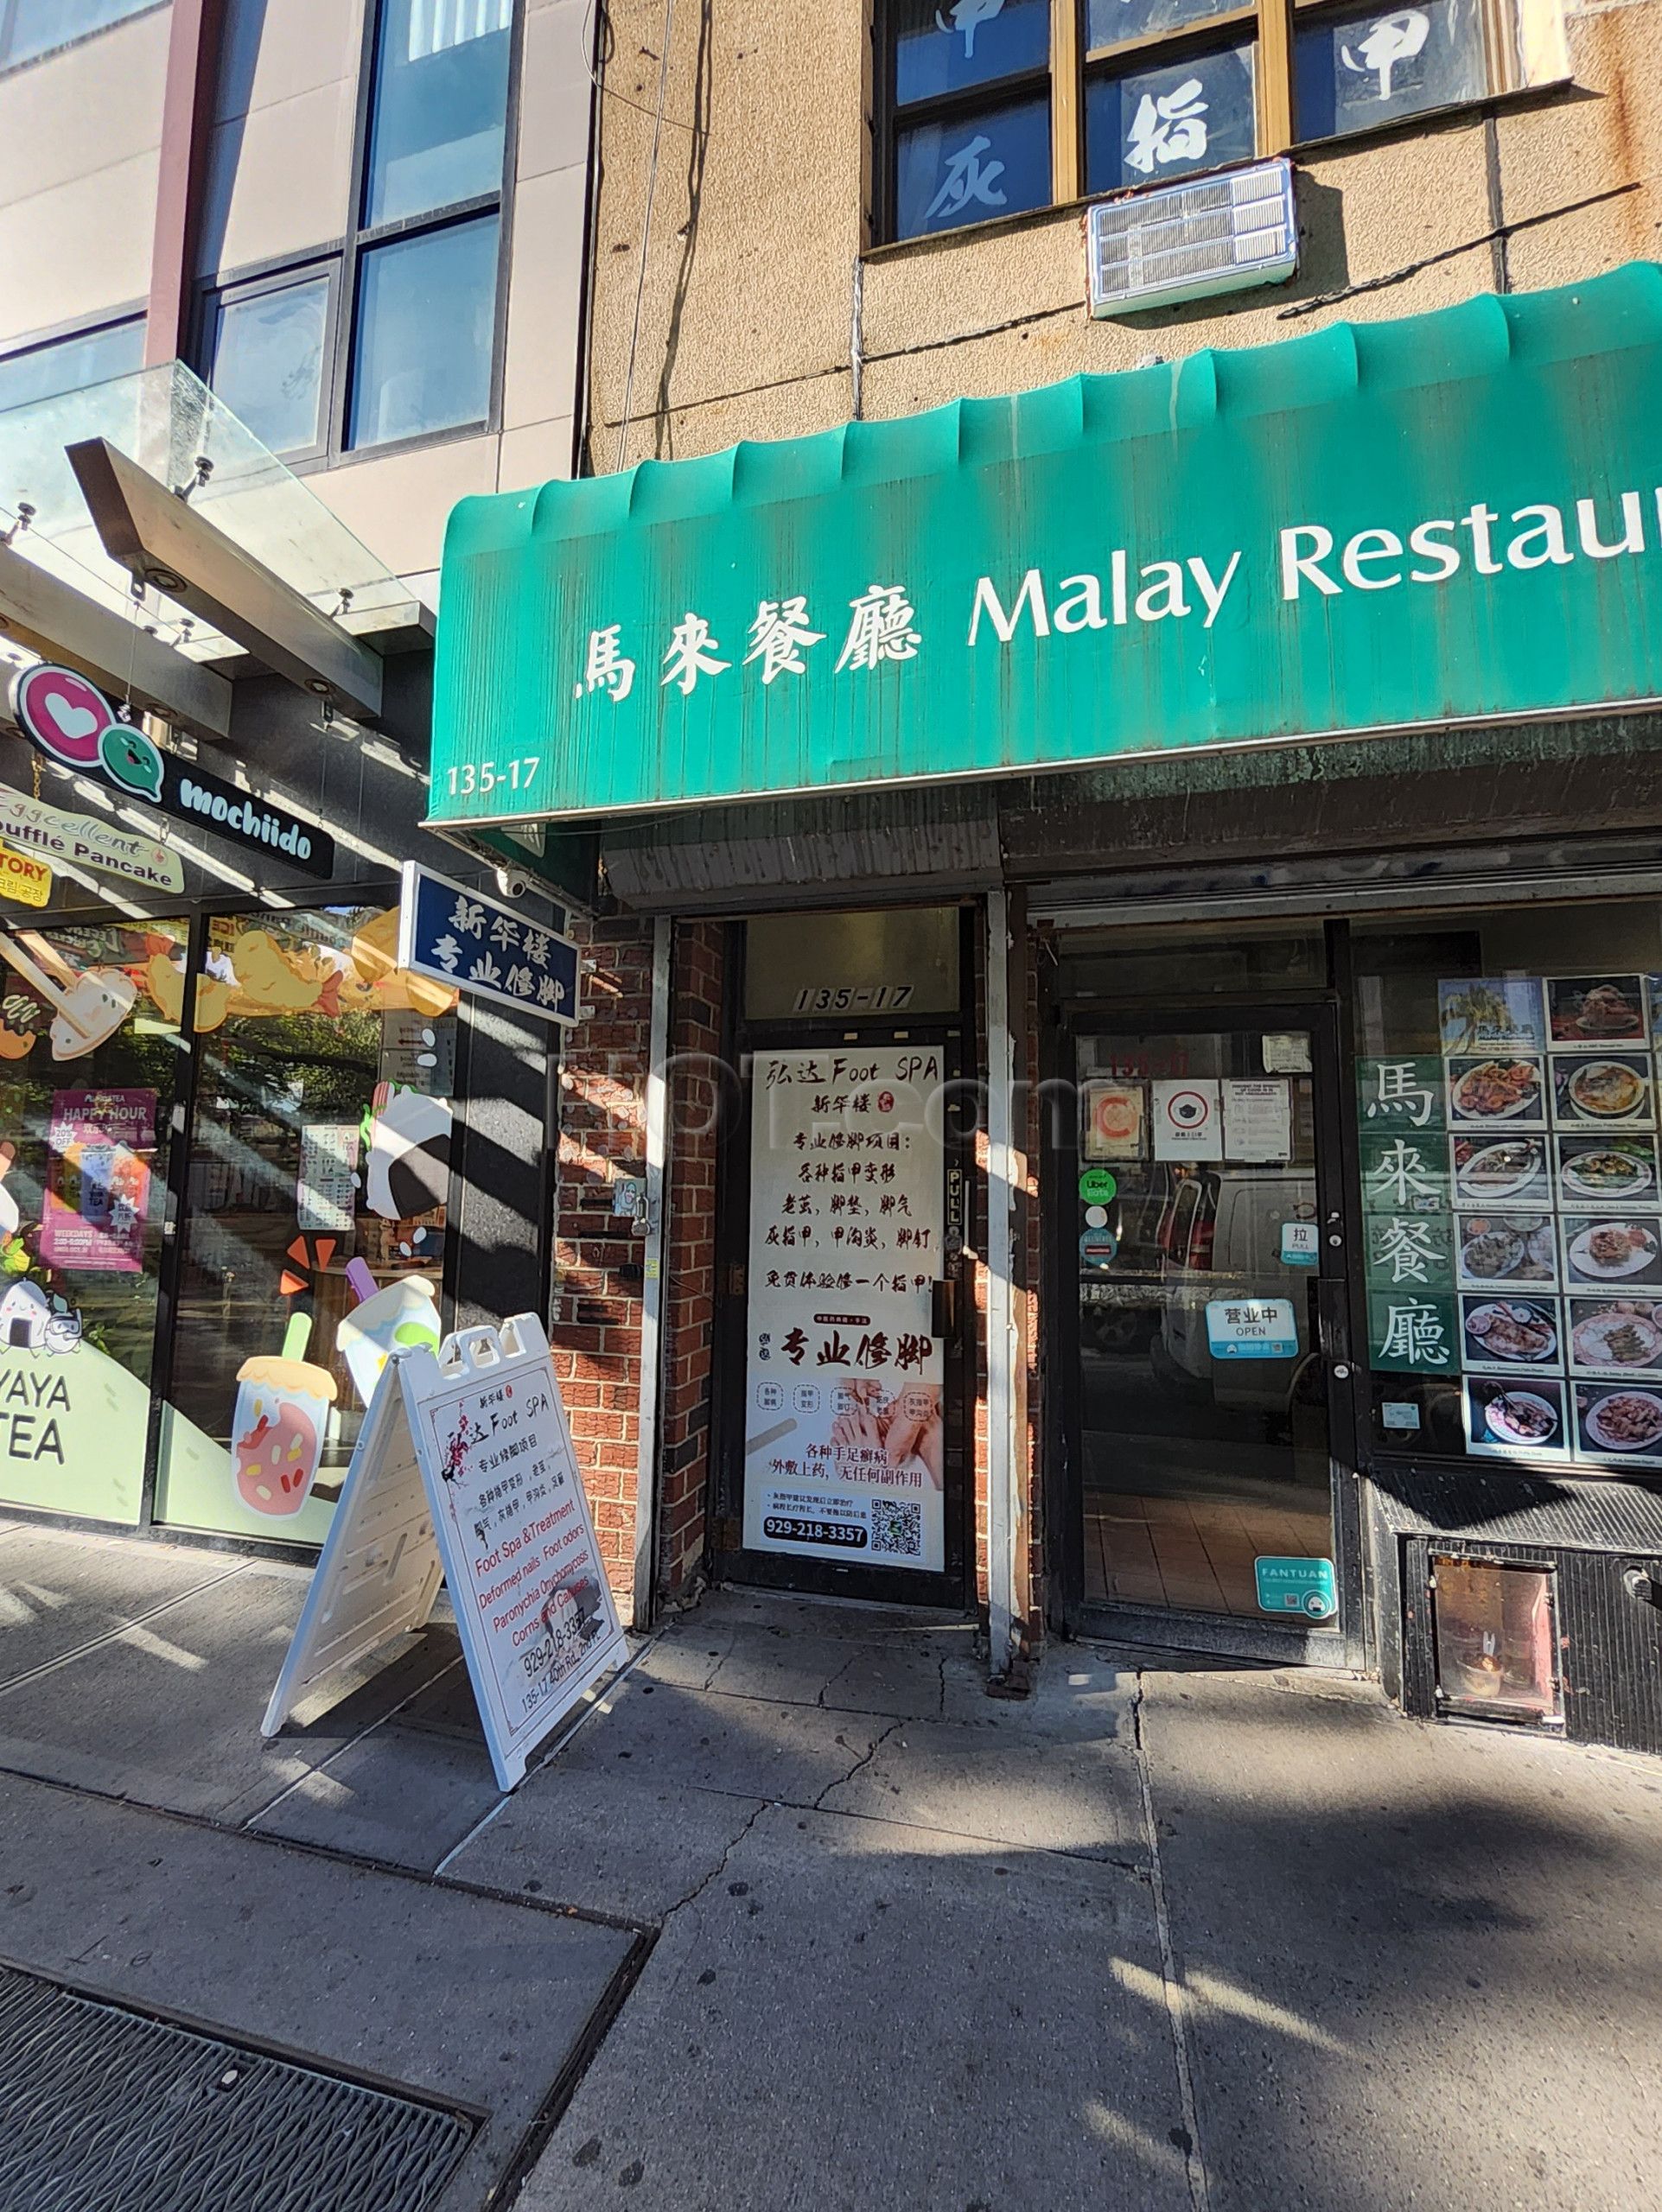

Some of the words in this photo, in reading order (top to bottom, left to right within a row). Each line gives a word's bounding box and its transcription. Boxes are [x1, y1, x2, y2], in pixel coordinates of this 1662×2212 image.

[967, 546, 1242, 647] Malay
[1279, 486, 1662, 602] Restau
[574, 583, 923, 703] 馬來餐廳
[447, 757, 541, 796] 135-17
[180, 778, 312, 861] mochiido
[73, 842, 173, 887] Pancake
[21, 880, 43, 902] 공장
[449, 894, 553, 970] 新华楼
[431, 932, 565, 1013] 专业修脚
[798, 986, 913, 1010] 135-17
[766, 1058, 827, 1090] 弘达
[831, 1058, 881, 1085] Foot
[895, 1056, 939, 1084] SPA
[109, 1106, 148, 1121] HOUR
[811, 1094, 872, 1114] 新华楼
[55, 1138, 71, 1147] OFF
[56, 1129, 72, 1138] 20%
[798, 1162, 896, 1185] 各种指甲变形
[1086, 1180, 1108, 1189] Uber
[949, 1172, 961, 1223] PULL
[1366, 1060, 1451, 1365] 馬來餐廳
[1293, 1227, 1309, 1242] 拉
[1224, 1306, 1278, 1325] 营业中
[1236, 1326, 1266, 1337] OPEN
[780, 1327, 933, 1376] 专业修脚
[490, 1410, 519, 1436] Foot
[525, 1393, 550, 1418] SPA
[766, 1518, 864, 1543] 929-218-3357
[475, 1548, 502, 1577] Foot
[501, 1537, 522, 1558] Spa
[479, 1568, 523, 1610] Deformed
[523, 1556, 541, 1578] nails
[543, 1539, 564, 1560] Foot
[564, 1523, 585, 1547] odors
[1262, 1567, 1328, 1580] FANTUAN
[493, 1588, 541, 1633] Paronychia
[512, 1618, 540, 1647] Corns
[541, 1602, 557, 1625] and
[557, 1575, 589, 1608] Calluses
[524, 1607, 586, 1678] 929-218-3357
[521, 1677, 549, 1713] 135-17
[549, 1661, 566, 1685] 40th
[579, 1638, 593, 1656] 2nd
